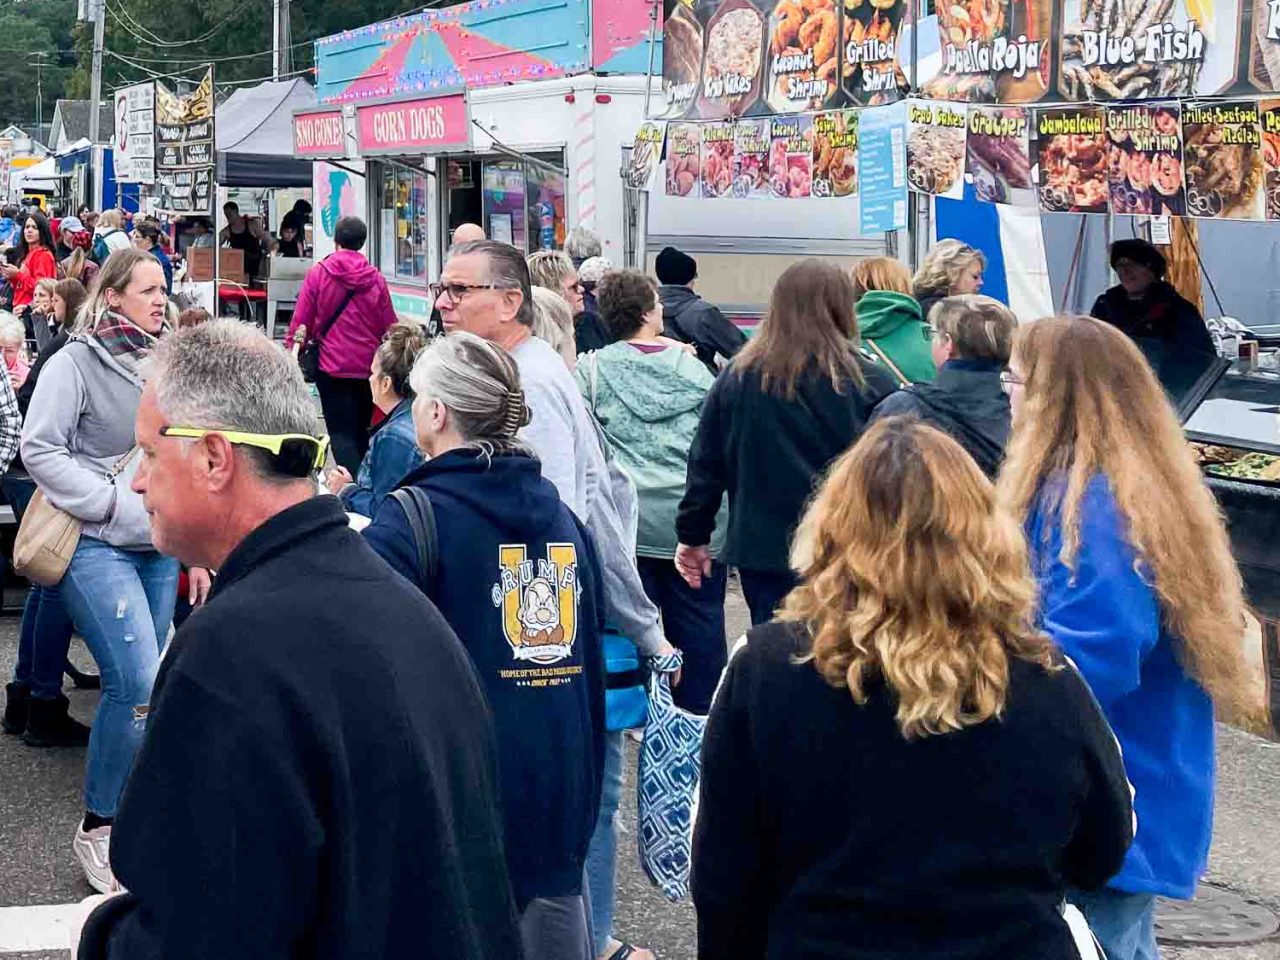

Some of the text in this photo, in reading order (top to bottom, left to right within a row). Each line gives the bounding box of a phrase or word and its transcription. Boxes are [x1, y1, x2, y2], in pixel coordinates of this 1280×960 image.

[846, 35, 896, 64] Grilled
[992, 34, 1039, 78] Roja
[1081, 20, 1204, 67] Blue Fish
[374, 105, 445, 143] CORN DOGS
[1040, 113, 1102, 139] Jambalaya
